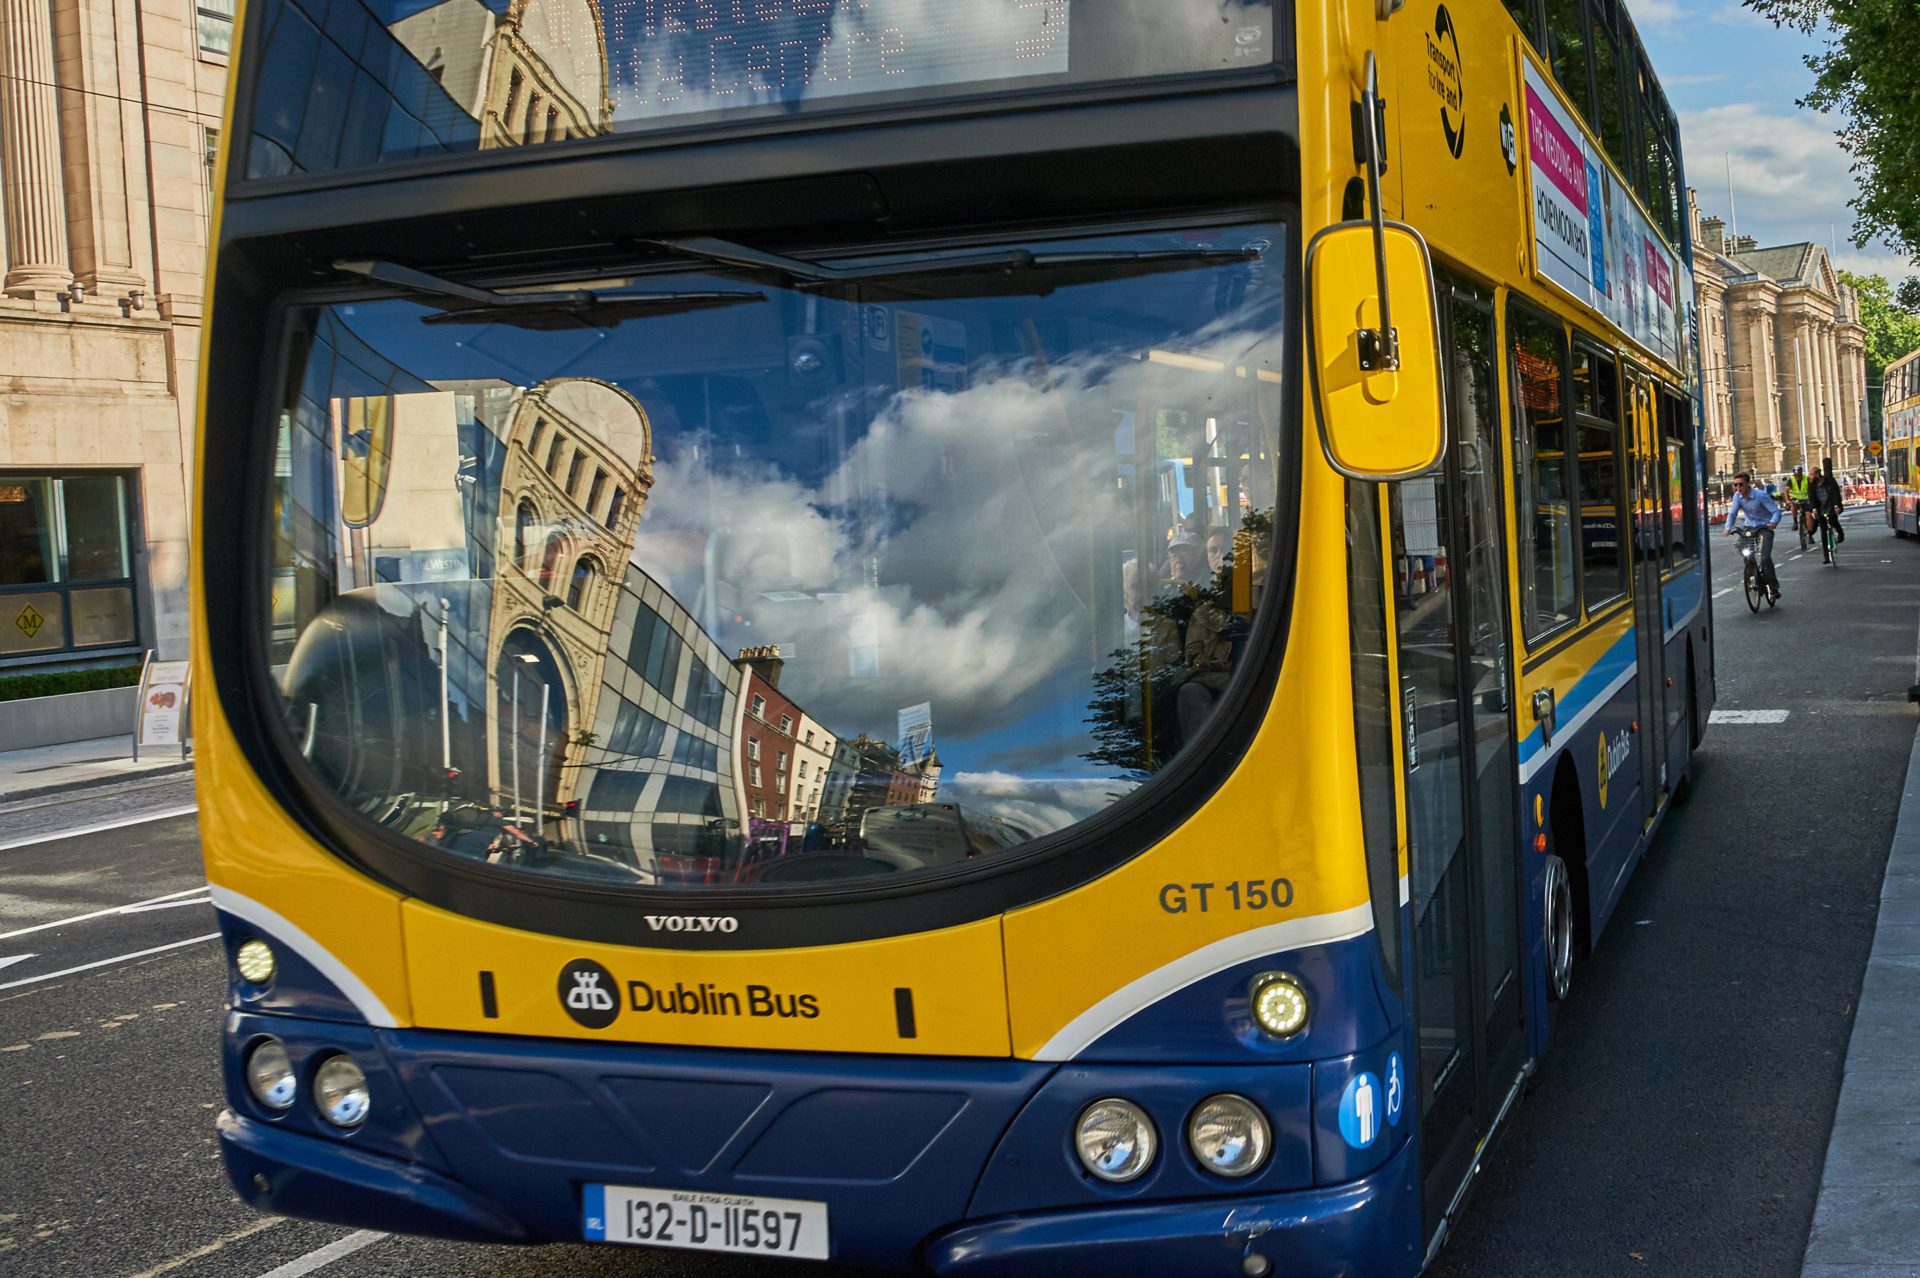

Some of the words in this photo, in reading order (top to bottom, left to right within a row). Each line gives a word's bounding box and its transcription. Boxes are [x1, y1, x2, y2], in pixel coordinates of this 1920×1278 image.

[580, 48, 685, 112] City
[710, 23, 905, 95] Centre
[1425, 31, 1456, 83] Transport
[1436, 71, 1457, 113] Ireand
[1530, 108, 1544, 153] THE
[1543, 125, 1573, 186] WEDDING
[1573, 161, 1585, 198] AND
[23, 614, 37, 629] M
[1159, 883, 1214, 914] GT
[1225, 878, 1294, 910] 150
[643, 915, 739, 933] VOLVO
[627, 980, 741, 1016] Dublin
[746, 984, 820, 1019] Bus
[626, 1199, 802, 1251] 132-D-11597
